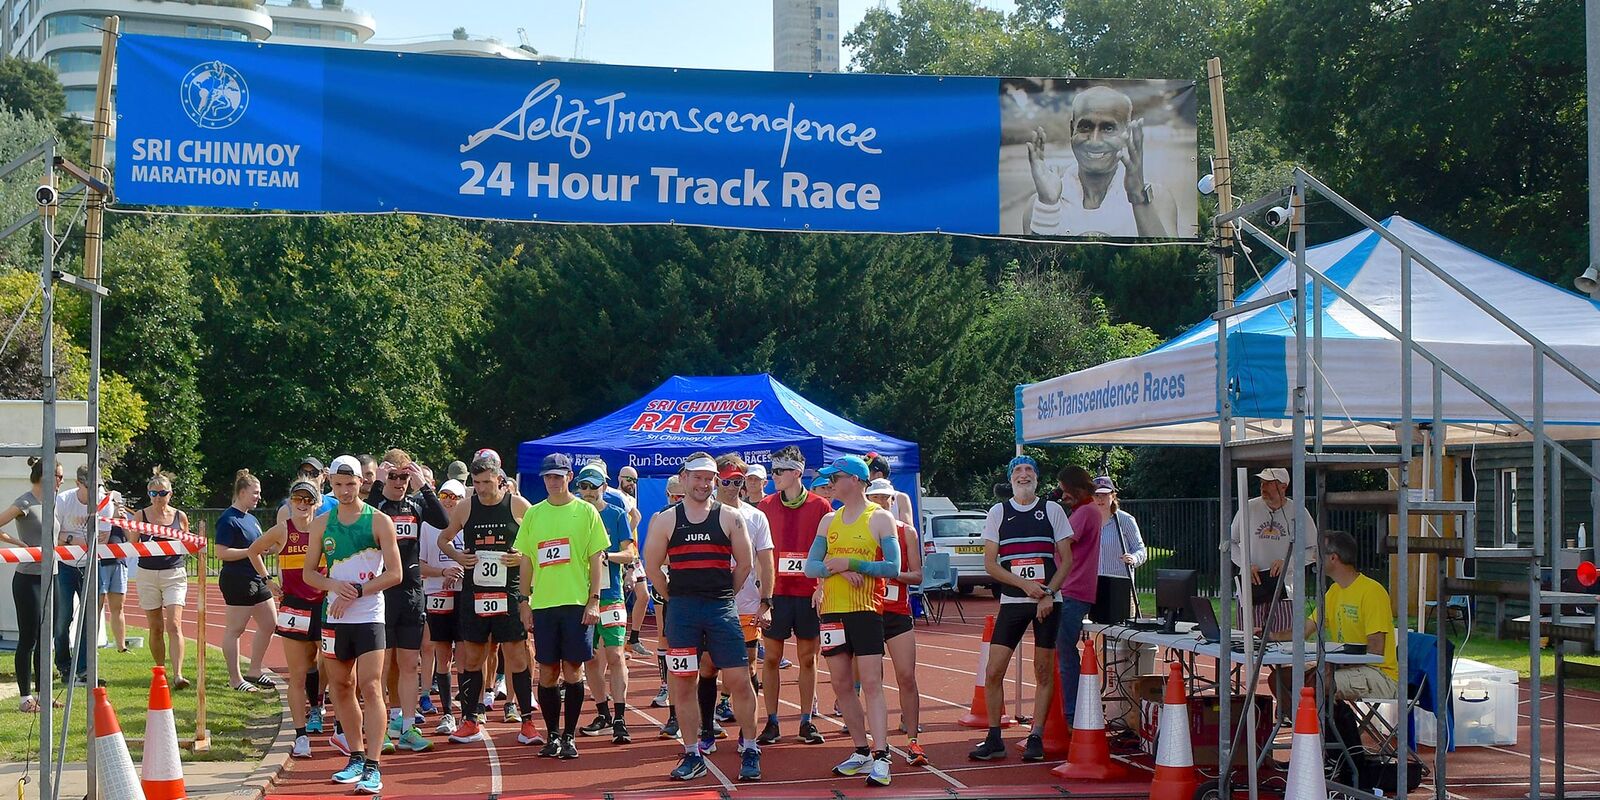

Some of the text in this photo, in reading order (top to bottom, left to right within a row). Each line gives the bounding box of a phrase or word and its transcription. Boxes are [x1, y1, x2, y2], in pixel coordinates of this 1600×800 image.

[460, 78, 882, 168] Self-Transcendence
[132, 138, 300, 167] SRI CHINMOY
[131, 164, 299, 188] MARATHON TEAM
[459, 160, 881, 211] 24 Hour Track Race
[1037, 372, 1185, 420] Self-Transcendence Races
[646, 400, 762, 412] SRI CHINMOY
[629, 412, 755, 434] RACES
[659, 434, 700, 443] Chinmoy
[575, 458, 592, 466] RAC
[629, 454, 650, 466] Run
[396, 524, 411, 535] 50
[684, 533, 711, 542] JURA
[546, 547, 560, 560] 42
[482, 562, 498, 577] 30
[787, 560, 803, 571] 24
[1020, 567, 1035, 578] 46
[432, 598, 446, 609] 37
[483, 600, 498, 612] 30
[287, 616, 296, 627] 4
[613, 611, 620, 621] 9
[824, 632, 831, 645] 3
[672, 657, 689, 670] 34
